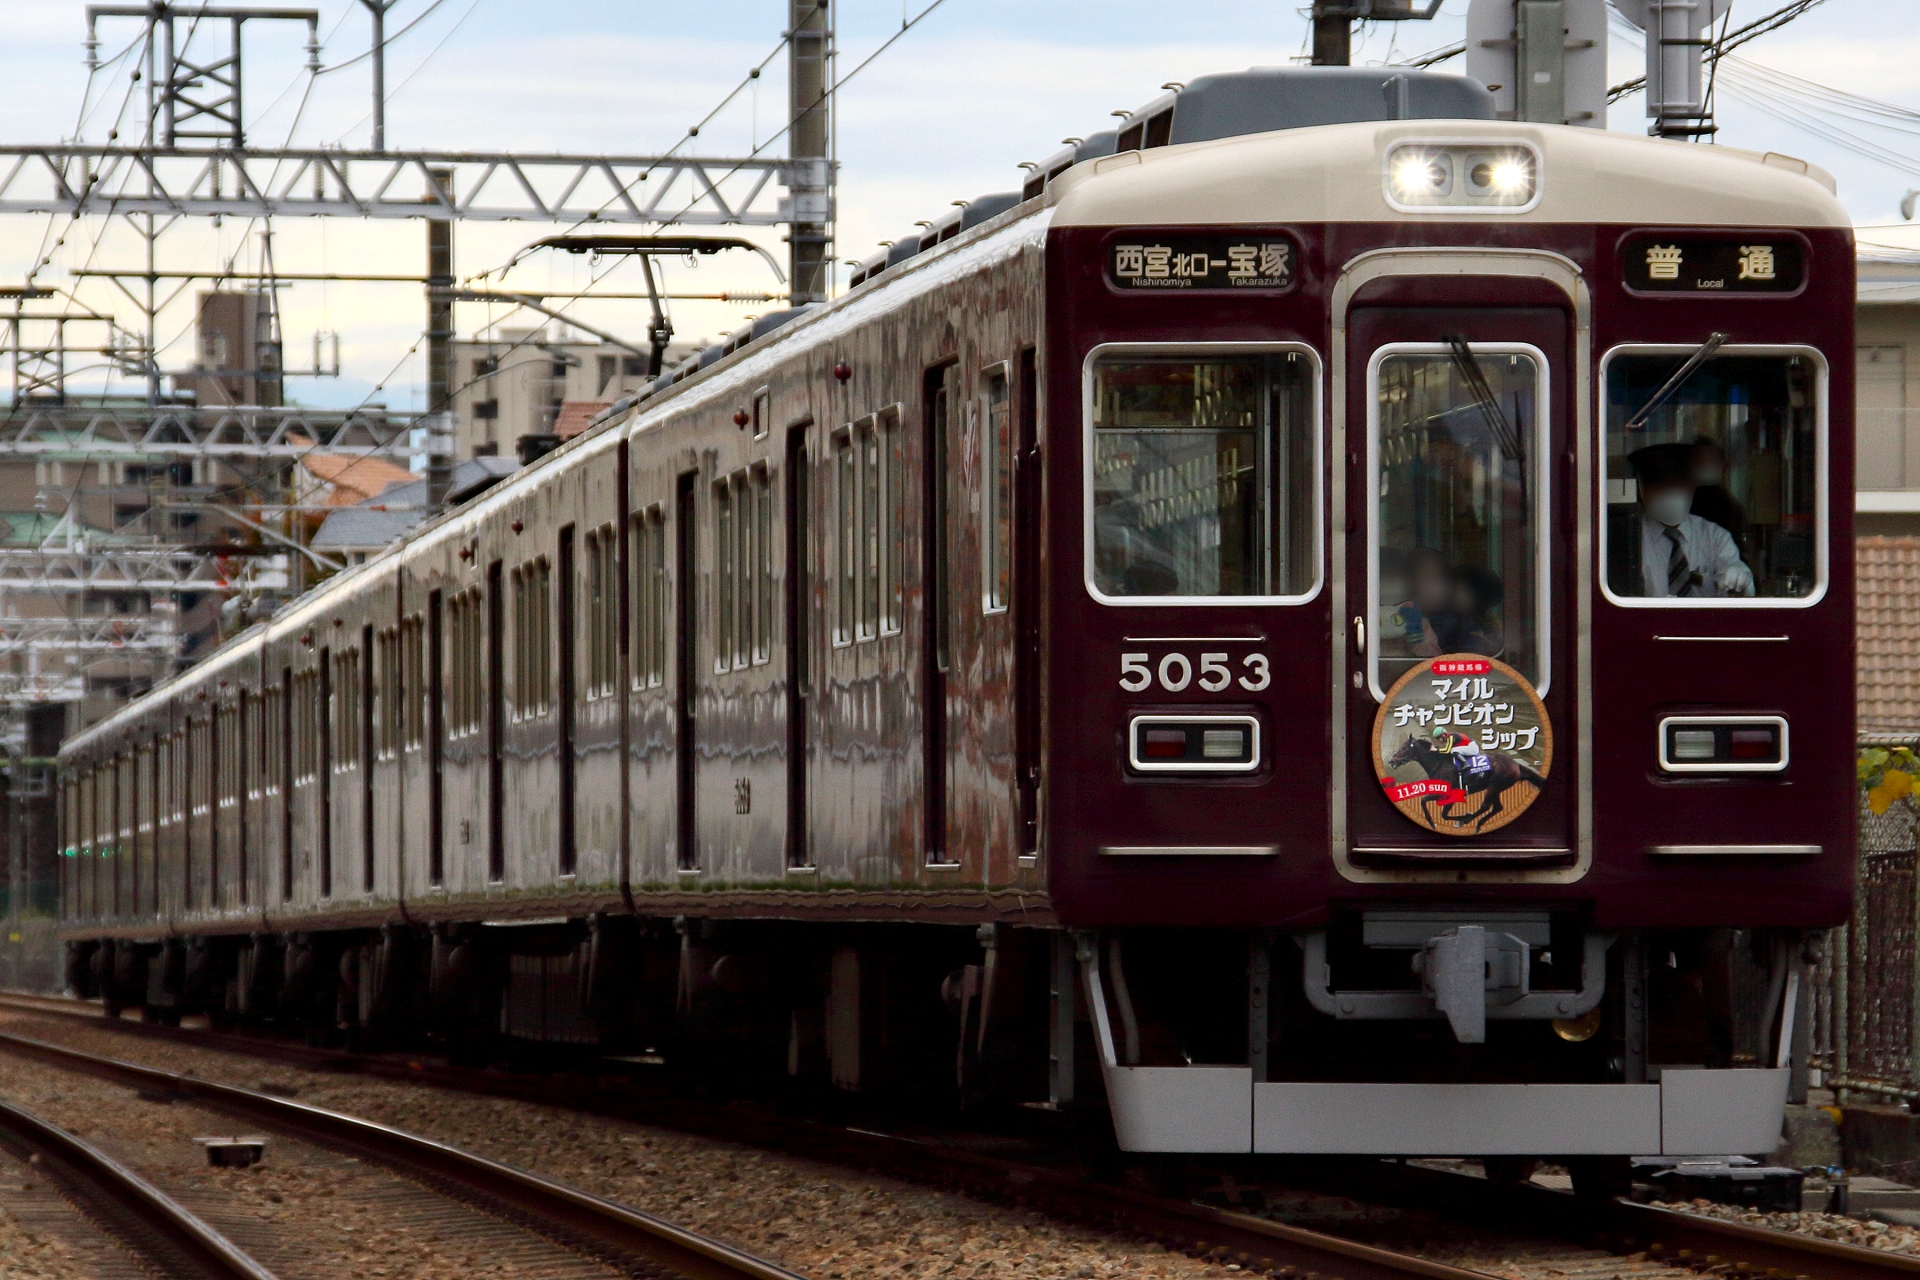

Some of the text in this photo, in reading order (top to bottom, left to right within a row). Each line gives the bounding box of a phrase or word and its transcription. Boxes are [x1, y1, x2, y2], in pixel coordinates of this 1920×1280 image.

[1132, 277, 1287, 288] Nishinomiya Takarazuka
[1697, 278, 1724, 288] Local
[1118, 653, 1271, 692] 5053
[1431, 677, 1494, 701] マイル
[1393, 702, 1514, 726] チャンピオン
[1481, 726, 1539, 750] シップ
[1471, 755, 1488, 767] 12
[1397, 783, 1448, 799] 11.20 sun
